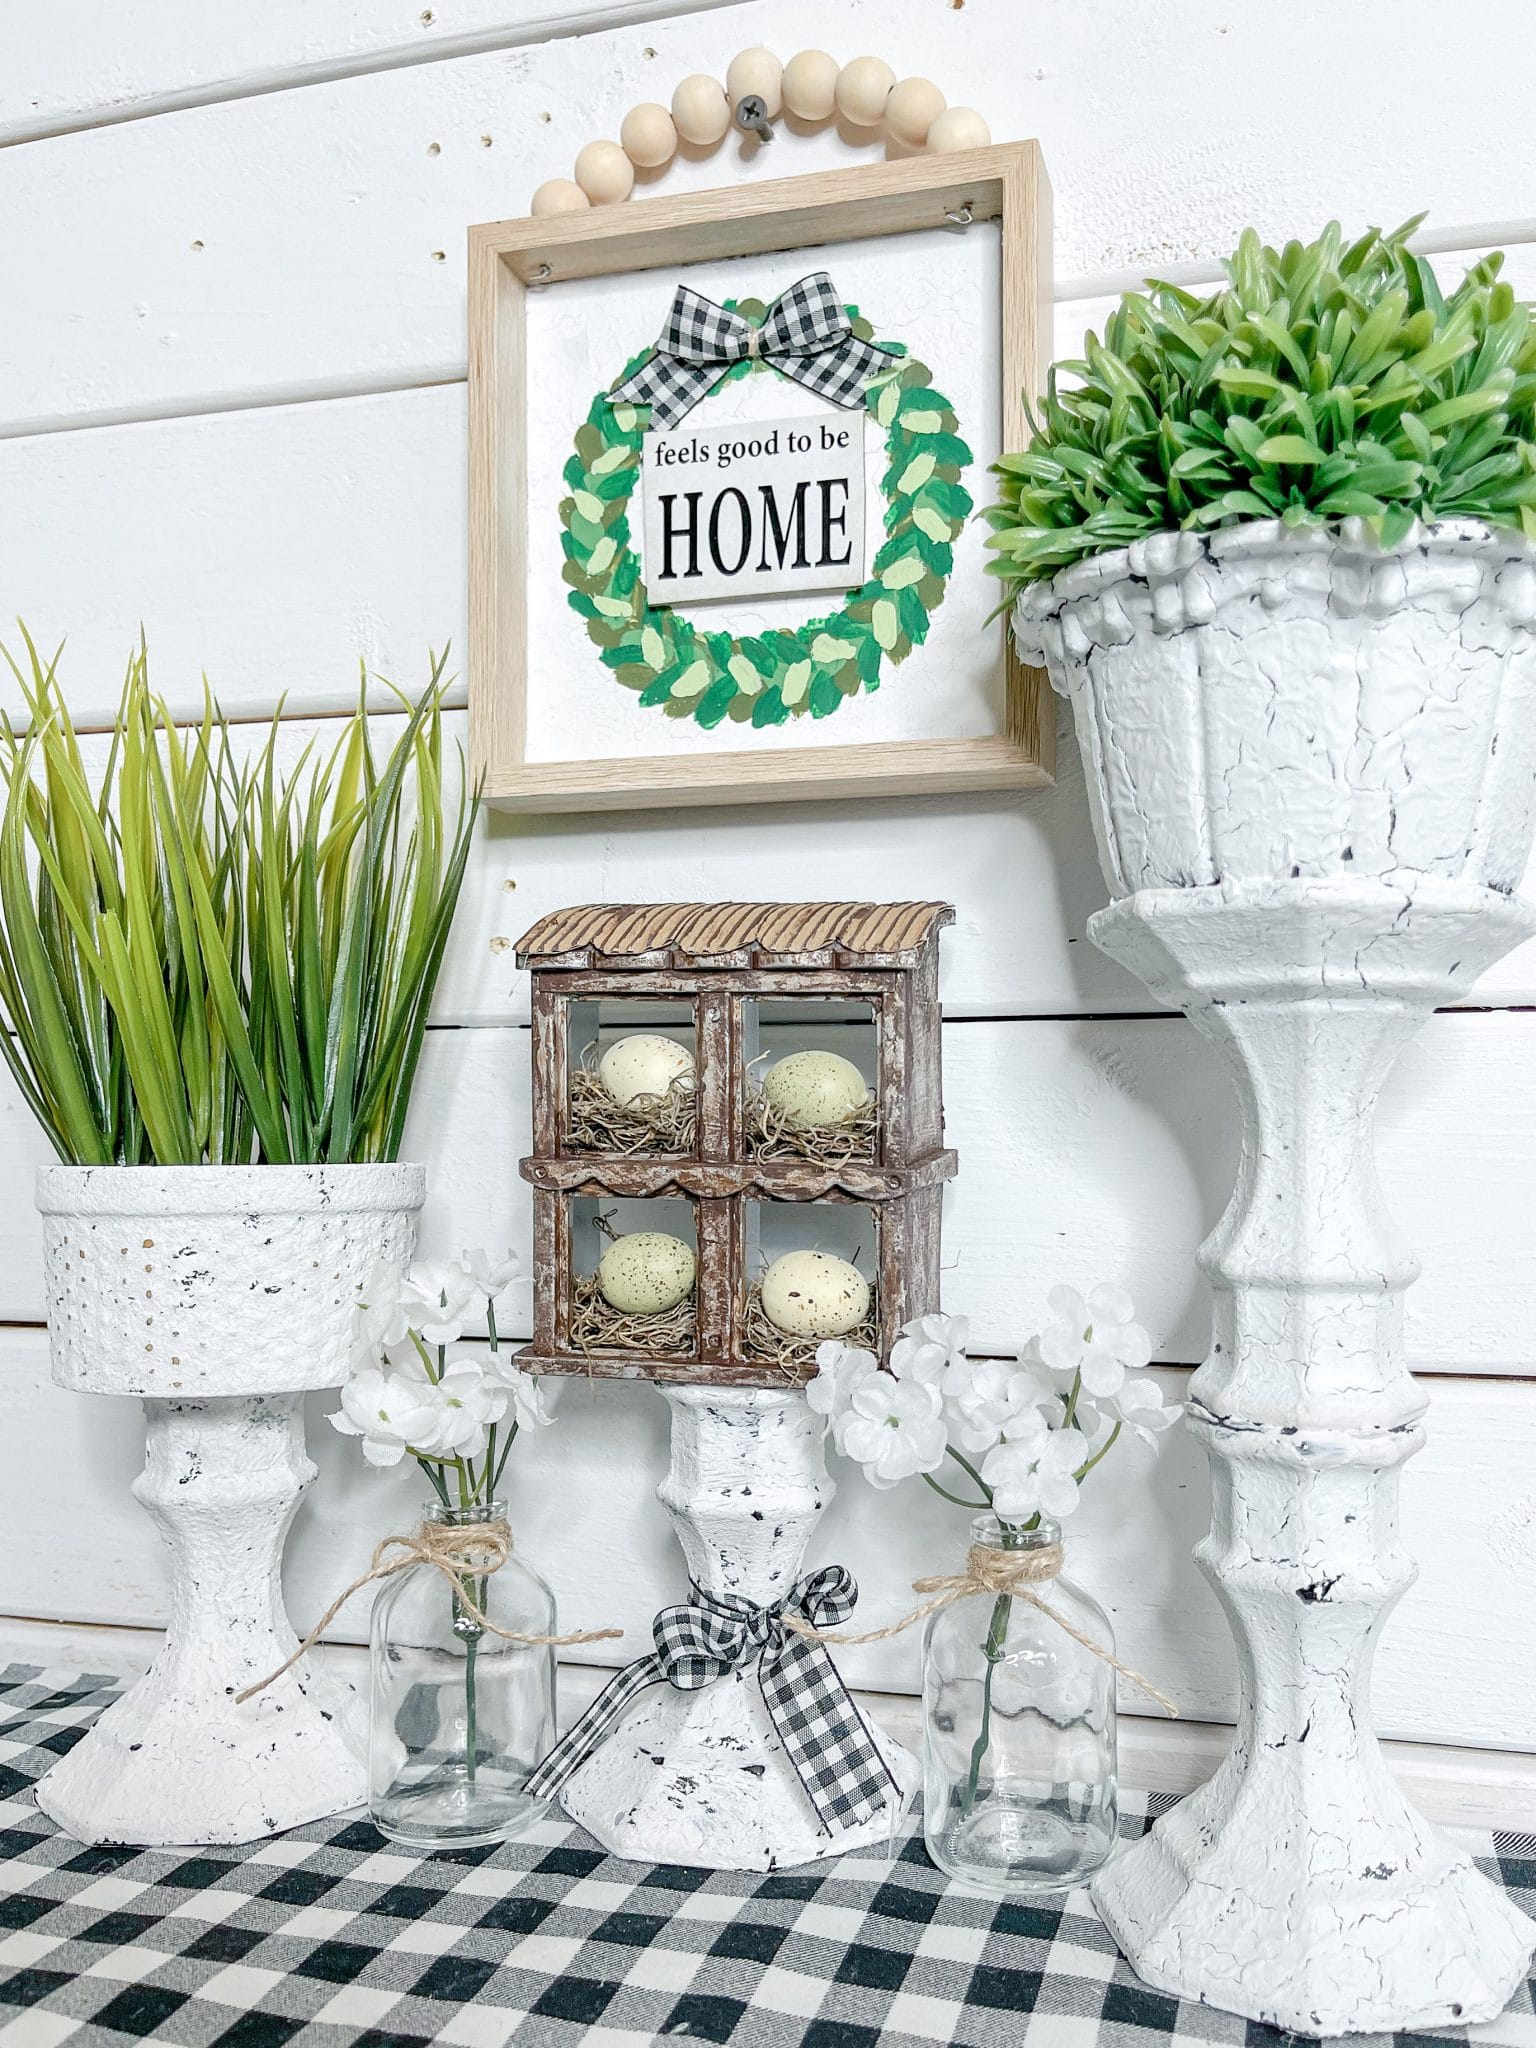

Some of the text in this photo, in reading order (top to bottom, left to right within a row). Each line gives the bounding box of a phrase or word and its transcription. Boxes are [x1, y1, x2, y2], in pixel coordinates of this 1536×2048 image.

[655, 425, 850, 468] feels good to be
[658, 477, 853, 580] HOME
